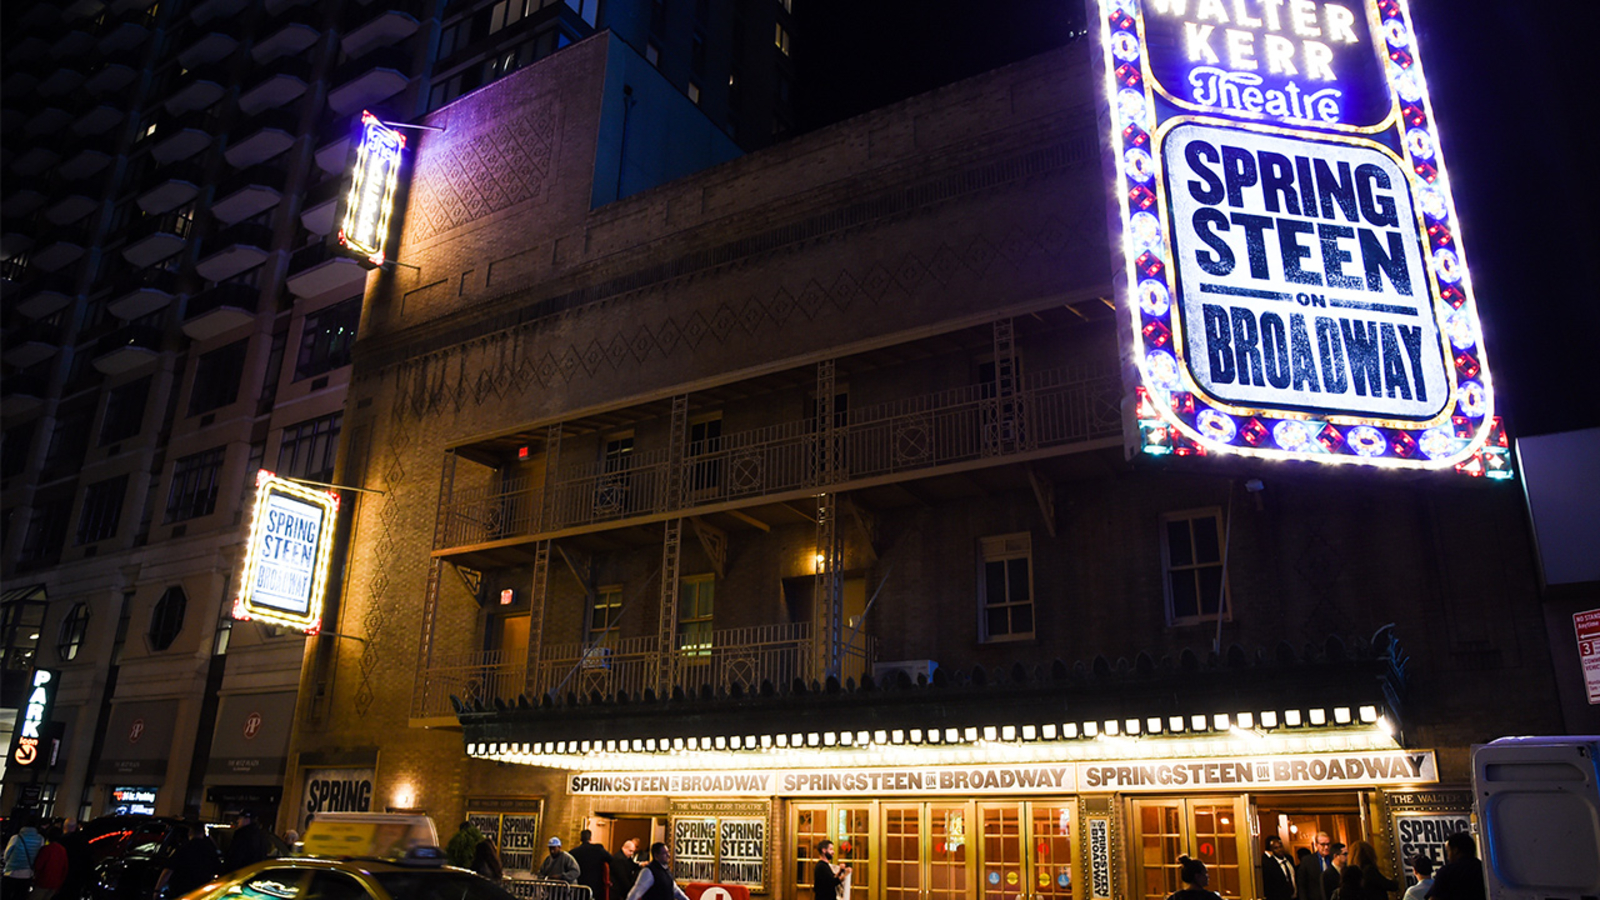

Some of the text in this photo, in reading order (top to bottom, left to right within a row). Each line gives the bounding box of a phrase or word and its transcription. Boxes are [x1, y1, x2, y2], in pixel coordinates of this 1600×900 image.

[1184, 21, 1338, 81] KERR
[1188, 66, 1342, 124] Theatre
[1184, 139, 1400, 229] SPRING
[1191, 207, 1414, 297] STEEN
[1296, 292, 1326, 308] ON
[1202, 303, 1428, 402] BROADWAY
[267, 509, 316, 543] SPRING
[262, 534, 312, 568] STEEN
[257, 565, 309, 598] BROADWAY
[1583, 643, 1591, 655] 3
[22, 670, 51, 738] PARK
[571, 776, 669, 792] SPRINGSTEEN
[681, 775, 770, 791] BROADWAY
[784, 768, 1067, 791] SPRINGSTEEN ON BROADWAY
[1086, 755, 1426, 787] SPRINGSTEEN ON BROADWAY
[306, 779, 371, 812] SPRING
[1392, 794, 1414, 804] THE
[504, 818, 535, 833] SPRING
[676, 821, 715, 838] SPRING
[721, 823, 763, 840] SPRING
[503, 833, 534, 848] STEEN
[675, 839, 715, 855] STEEN
[721, 840, 763, 857] STEEN
[674, 861, 715, 880] BROADWAY
[720, 863, 762, 882] BROADWAY
[1091, 829, 1101, 896] BROADWAY
[1098, 821, 1109, 897] SPRINGSTEEN
